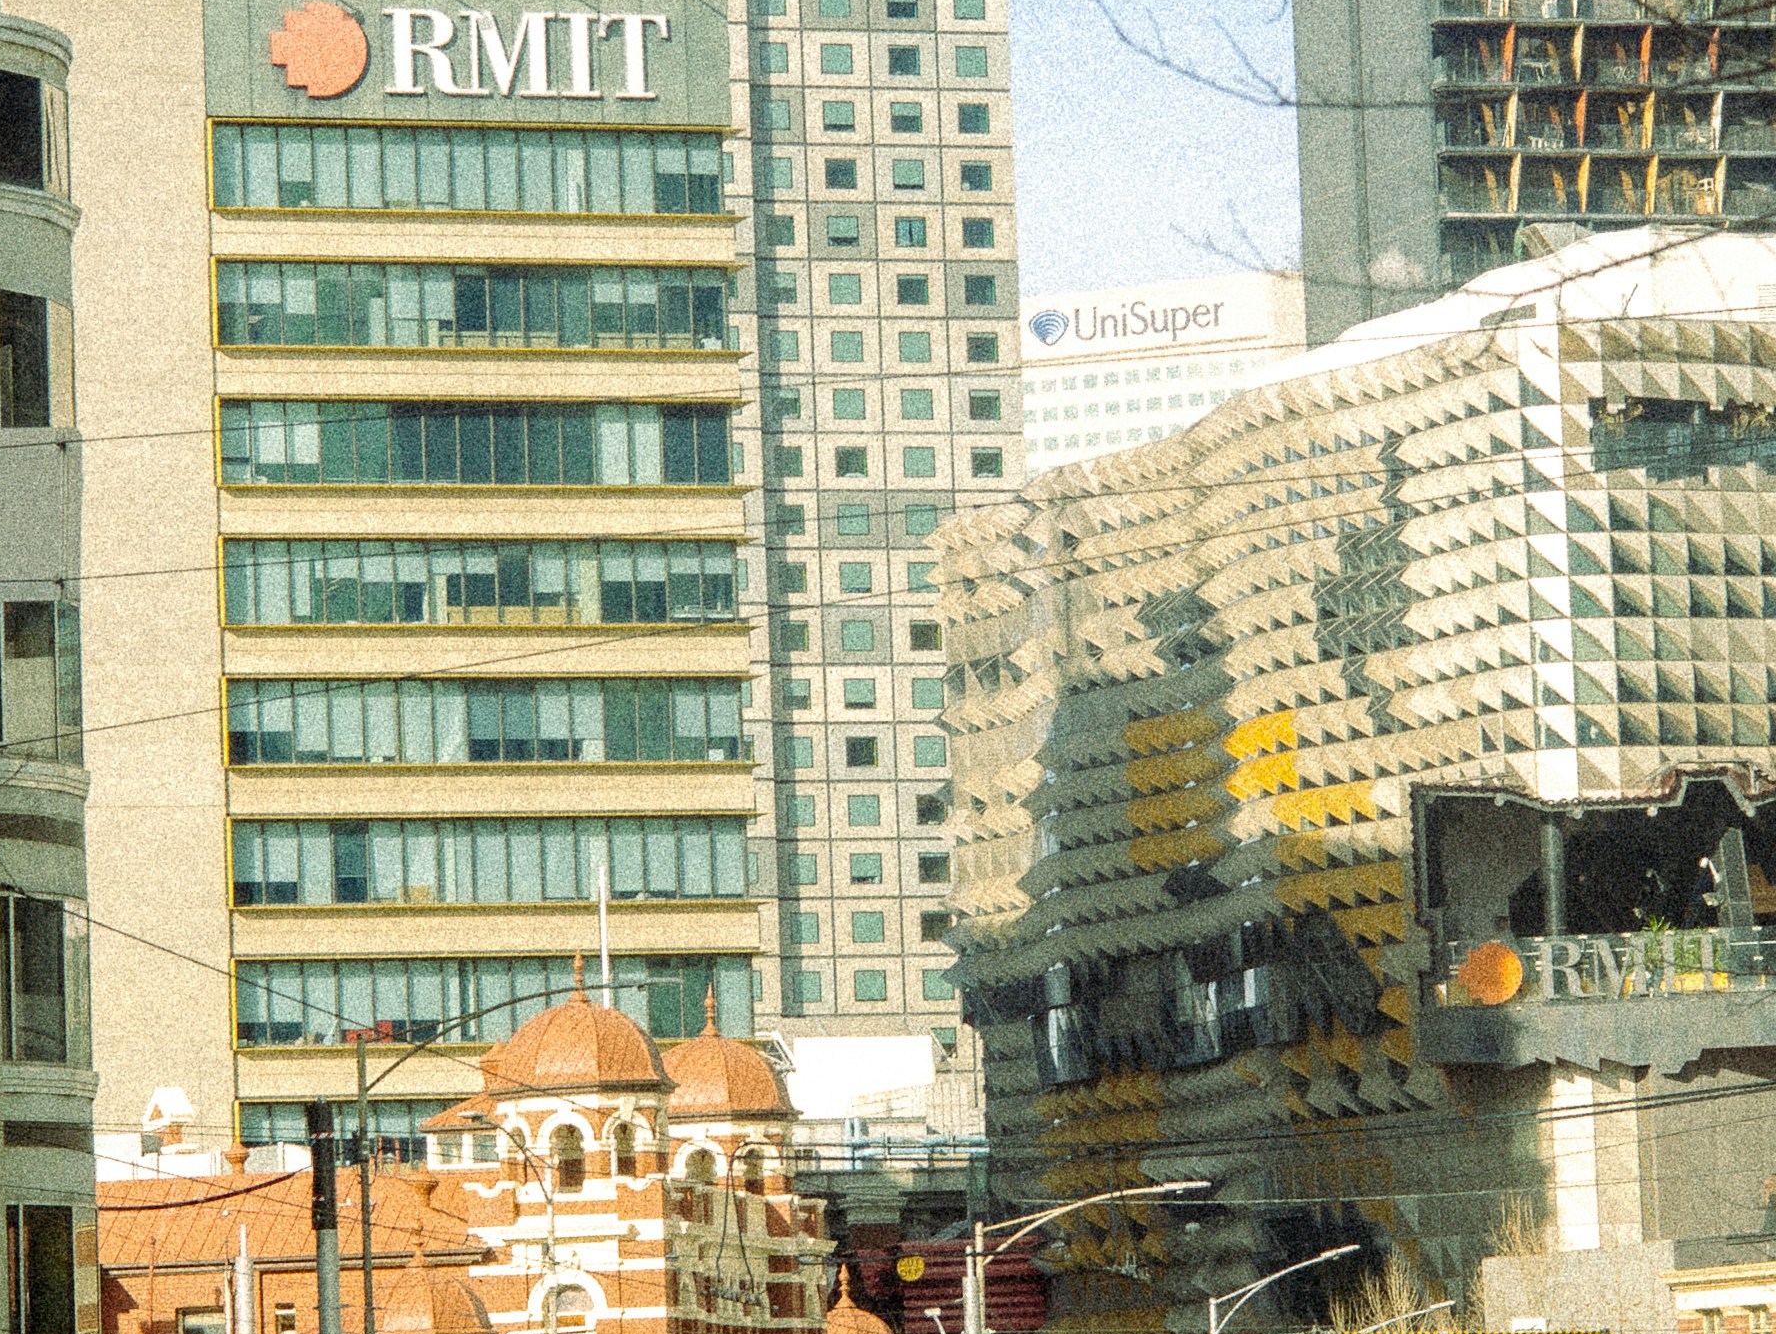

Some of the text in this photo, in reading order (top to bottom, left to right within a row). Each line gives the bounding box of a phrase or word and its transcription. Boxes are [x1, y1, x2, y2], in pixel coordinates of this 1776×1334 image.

[383, 6, 670, 100] RMIT
[1074, 300, 1224, 341] UniSuper
[1533, 933, 1731, 1000] RMIT
